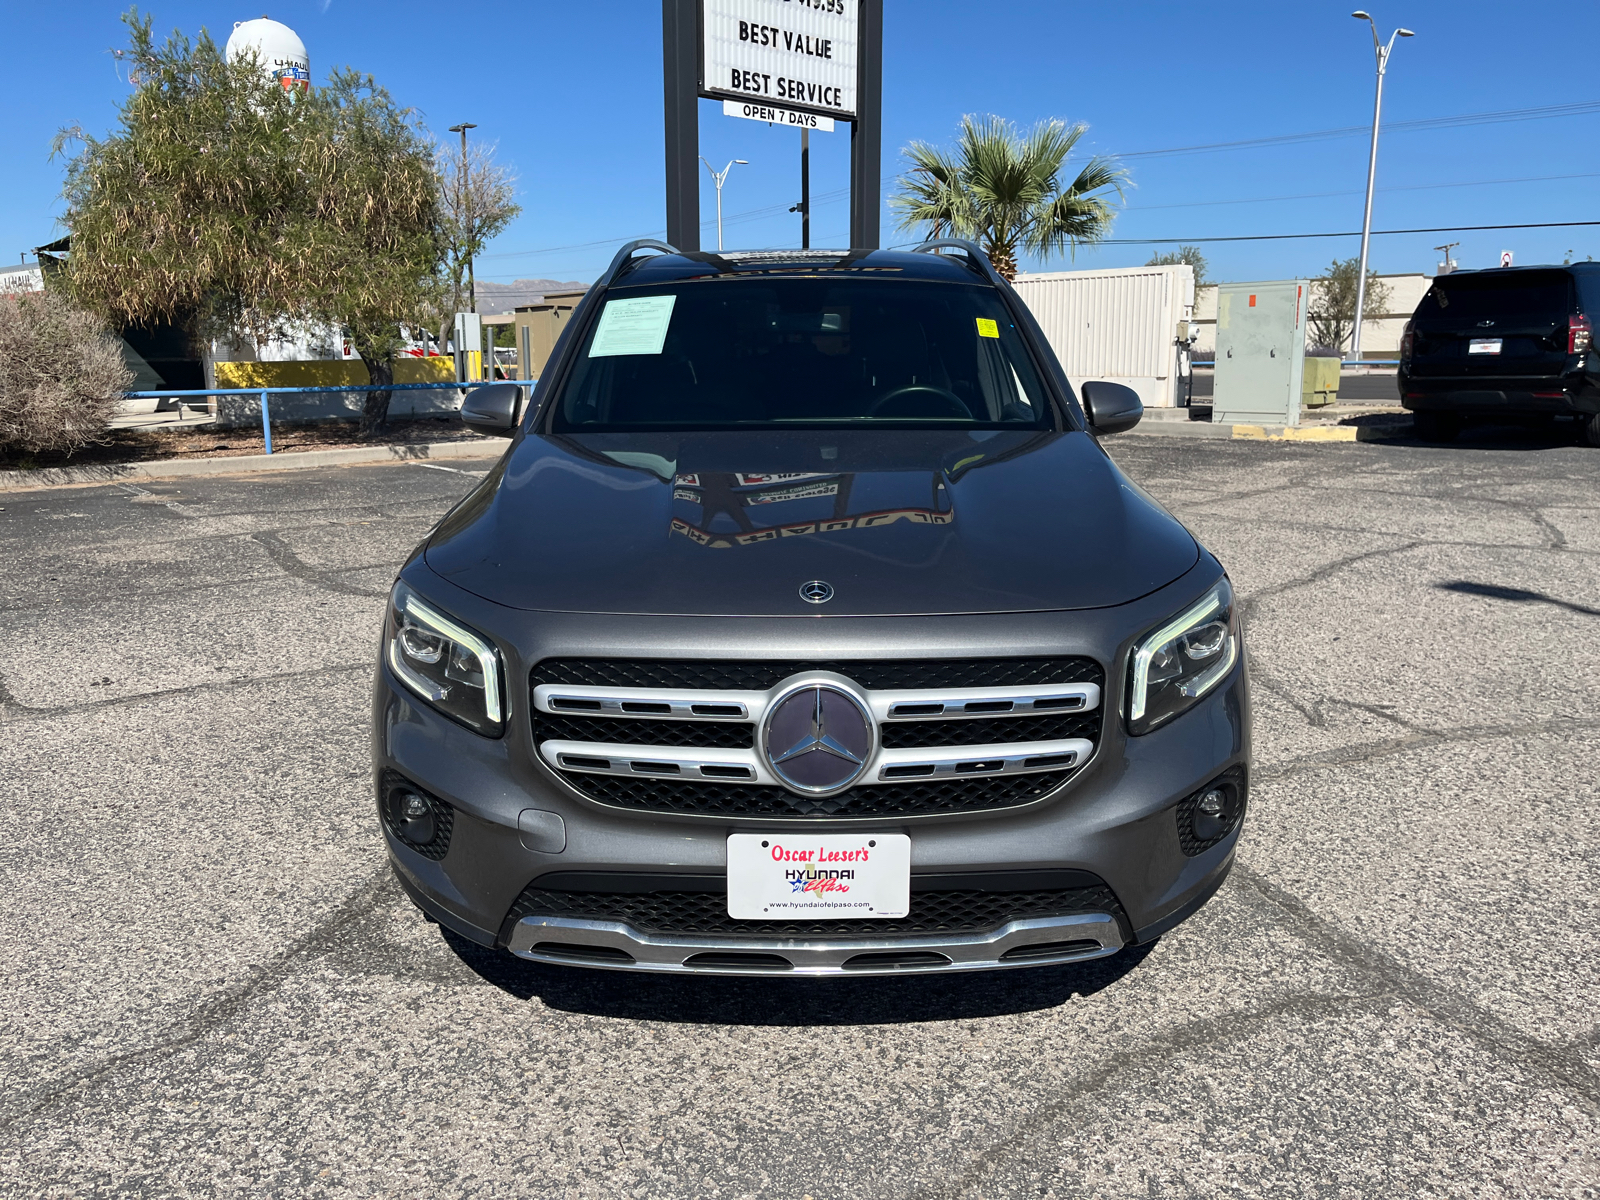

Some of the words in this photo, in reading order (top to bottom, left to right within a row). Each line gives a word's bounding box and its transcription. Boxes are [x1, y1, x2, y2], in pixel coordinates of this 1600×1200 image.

[739, 20, 779, 48] BEST
[784, 30, 832, 59] VALUE
[731, 68, 771, 94] BEST
[777, 76, 842, 107] SERVICE
[743, 104, 775, 121] OPEN
[779, 110, 785, 122] 7
[789, 112, 817, 127] DAYS
[771, 845, 815, 862] Oscar
[818, 846, 869, 862] Leeser's
[785, 869, 855, 880] HYUNDAI
[769, 901, 870, 909] www.hyundaiofelpaso.com
